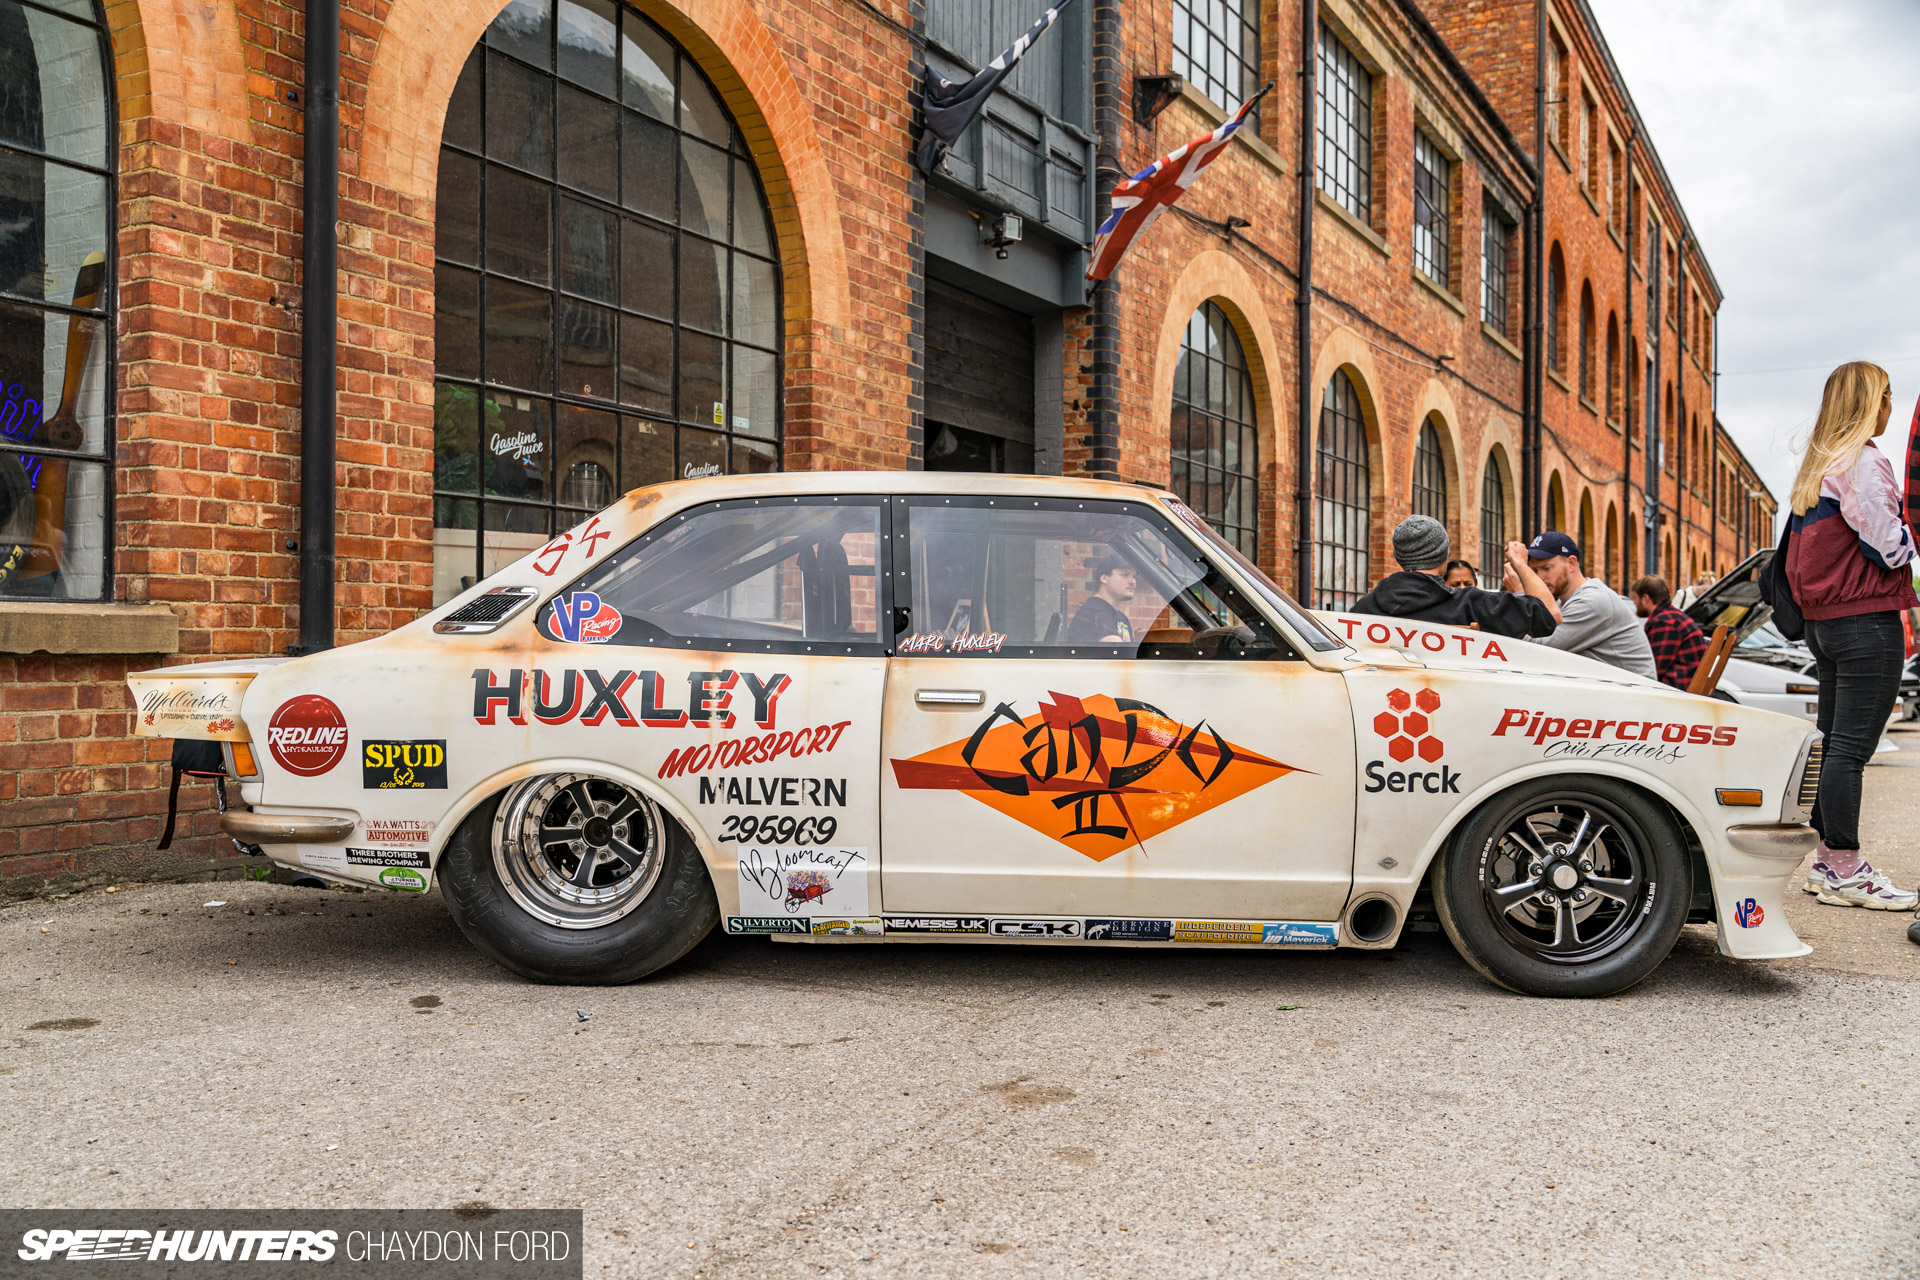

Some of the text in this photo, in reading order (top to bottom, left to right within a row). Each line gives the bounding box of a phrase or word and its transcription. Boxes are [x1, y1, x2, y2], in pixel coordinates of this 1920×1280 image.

[490, 431, 537, 455] Gasoline
[513, 440, 543, 460] Juice
[684, 462, 719, 479] Gasoline
[551, 591, 601, 642] VP
[582, 617, 621, 636] Racing
[898, 631, 1007, 653] MARC HUXLEY
[1337, 618, 1508, 662] TOYOTA
[471, 668, 792, 730] HUXLEY
[1491, 708, 1738, 746] Pipercross
[269, 727, 347, 753] REDLINE
[657, 721, 851, 779] MOTORSPORT
[365, 744, 444, 768] SPUD
[1596, 741, 1686, 764] Filters
[1365, 760, 1461, 794] Serck
[700, 777, 847, 807] MALVERN
[368, 831, 427, 841] AUTOMOTIVE
[718, 815, 837, 845] 295969
[347, 856, 424, 867] BREWING COMPANY
[350, 849, 418, 859] THREE BROTHERS
[739, 849, 866, 900] Bloomcart
[884, 918, 986, 929] NEMESIS UK
[1111, 920, 1170, 928] CERVINE
[1736, 898, 1756, 928] VP
[730, 918, 808, 932] SILVERTON
[995, 922, 1076, 935] CSK
[1178, 931, 1253, 940] SCAFFOLDING
[1180, 922, 1253, 931] INDEPENDENT
[1283, 934, 1328, 944] Maverick
